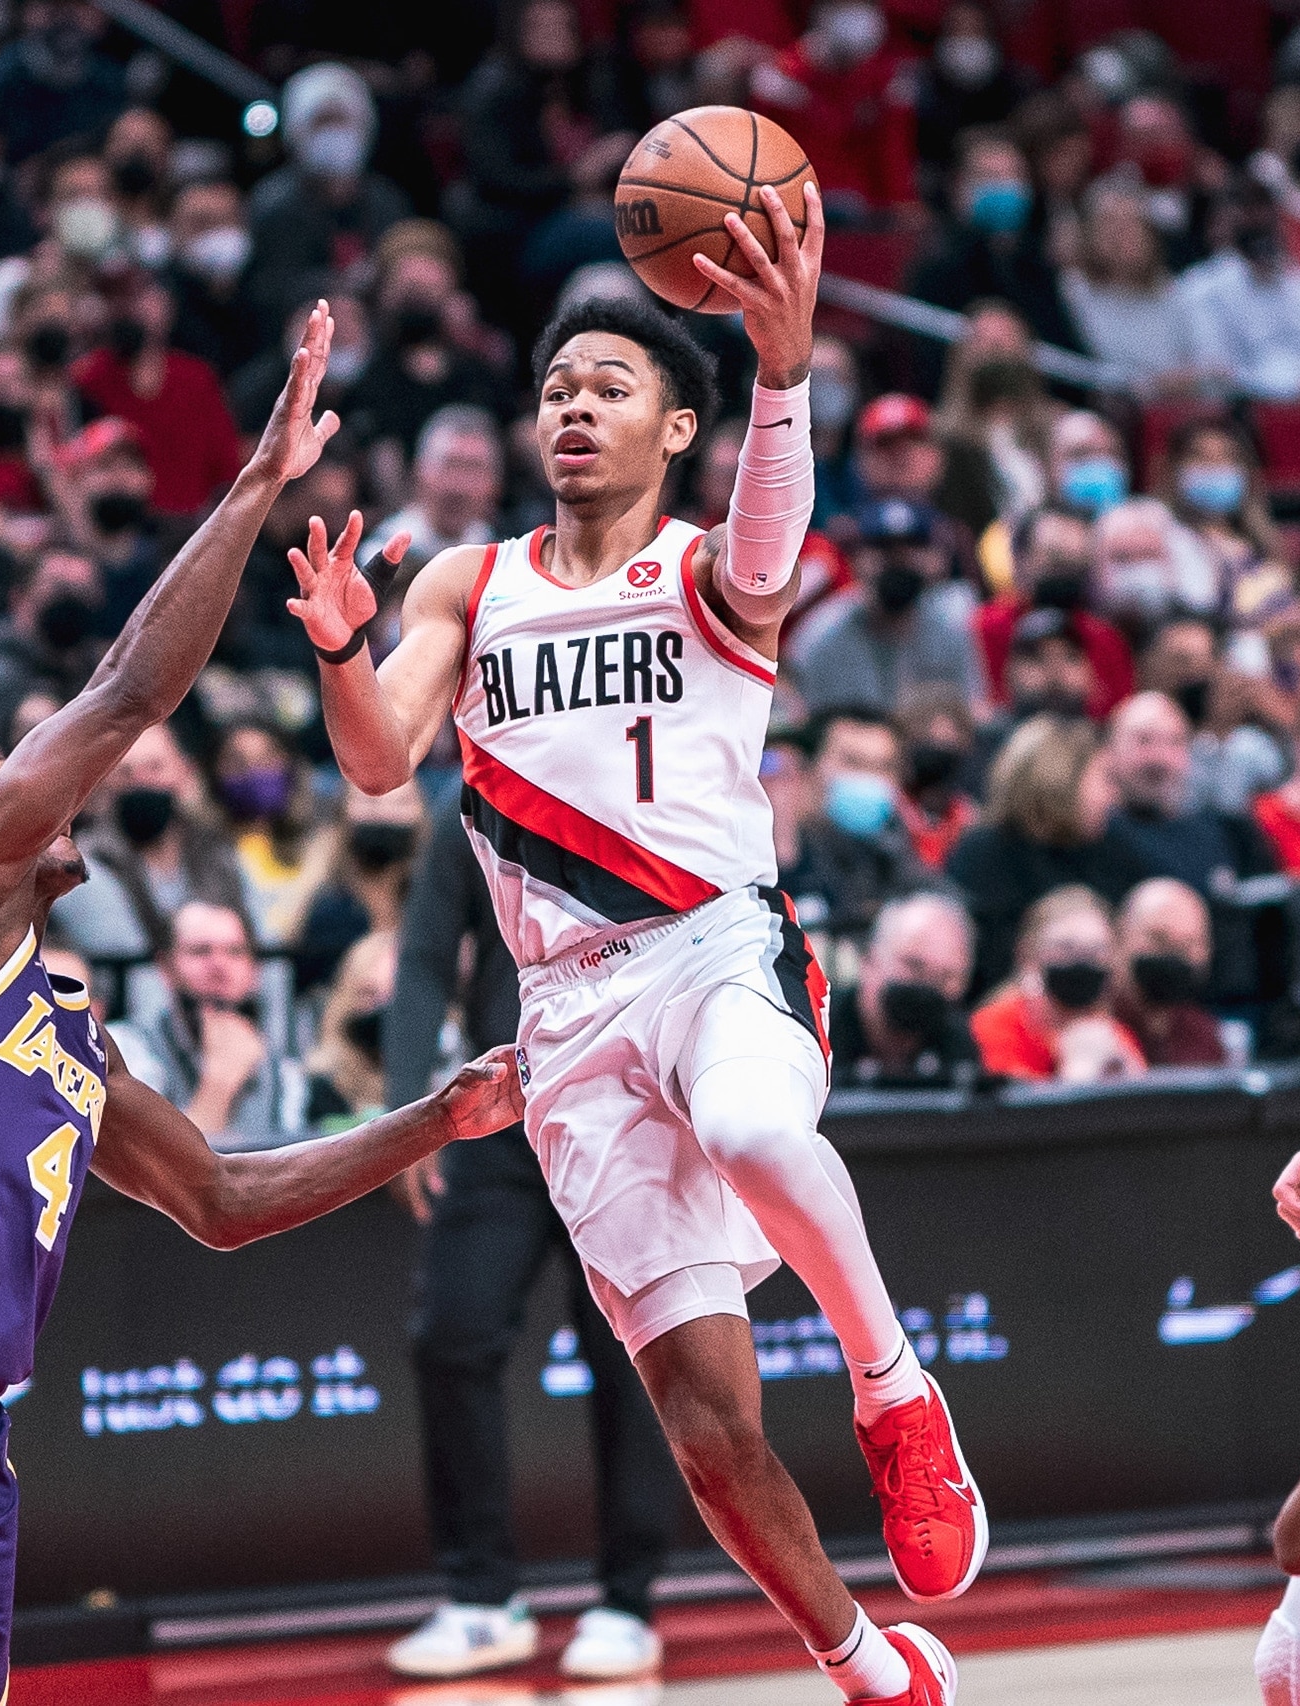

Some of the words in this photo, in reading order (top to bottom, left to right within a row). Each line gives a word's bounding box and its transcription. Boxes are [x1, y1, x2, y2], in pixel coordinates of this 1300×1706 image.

[619, 585, 667, 600] StormX
[477, 630, 683, 727] BLAZERS
[626, 715, 654, 803] 1
[579, 938, 632, 970] ripcity
[26, 1121, 81, 1252] 4
